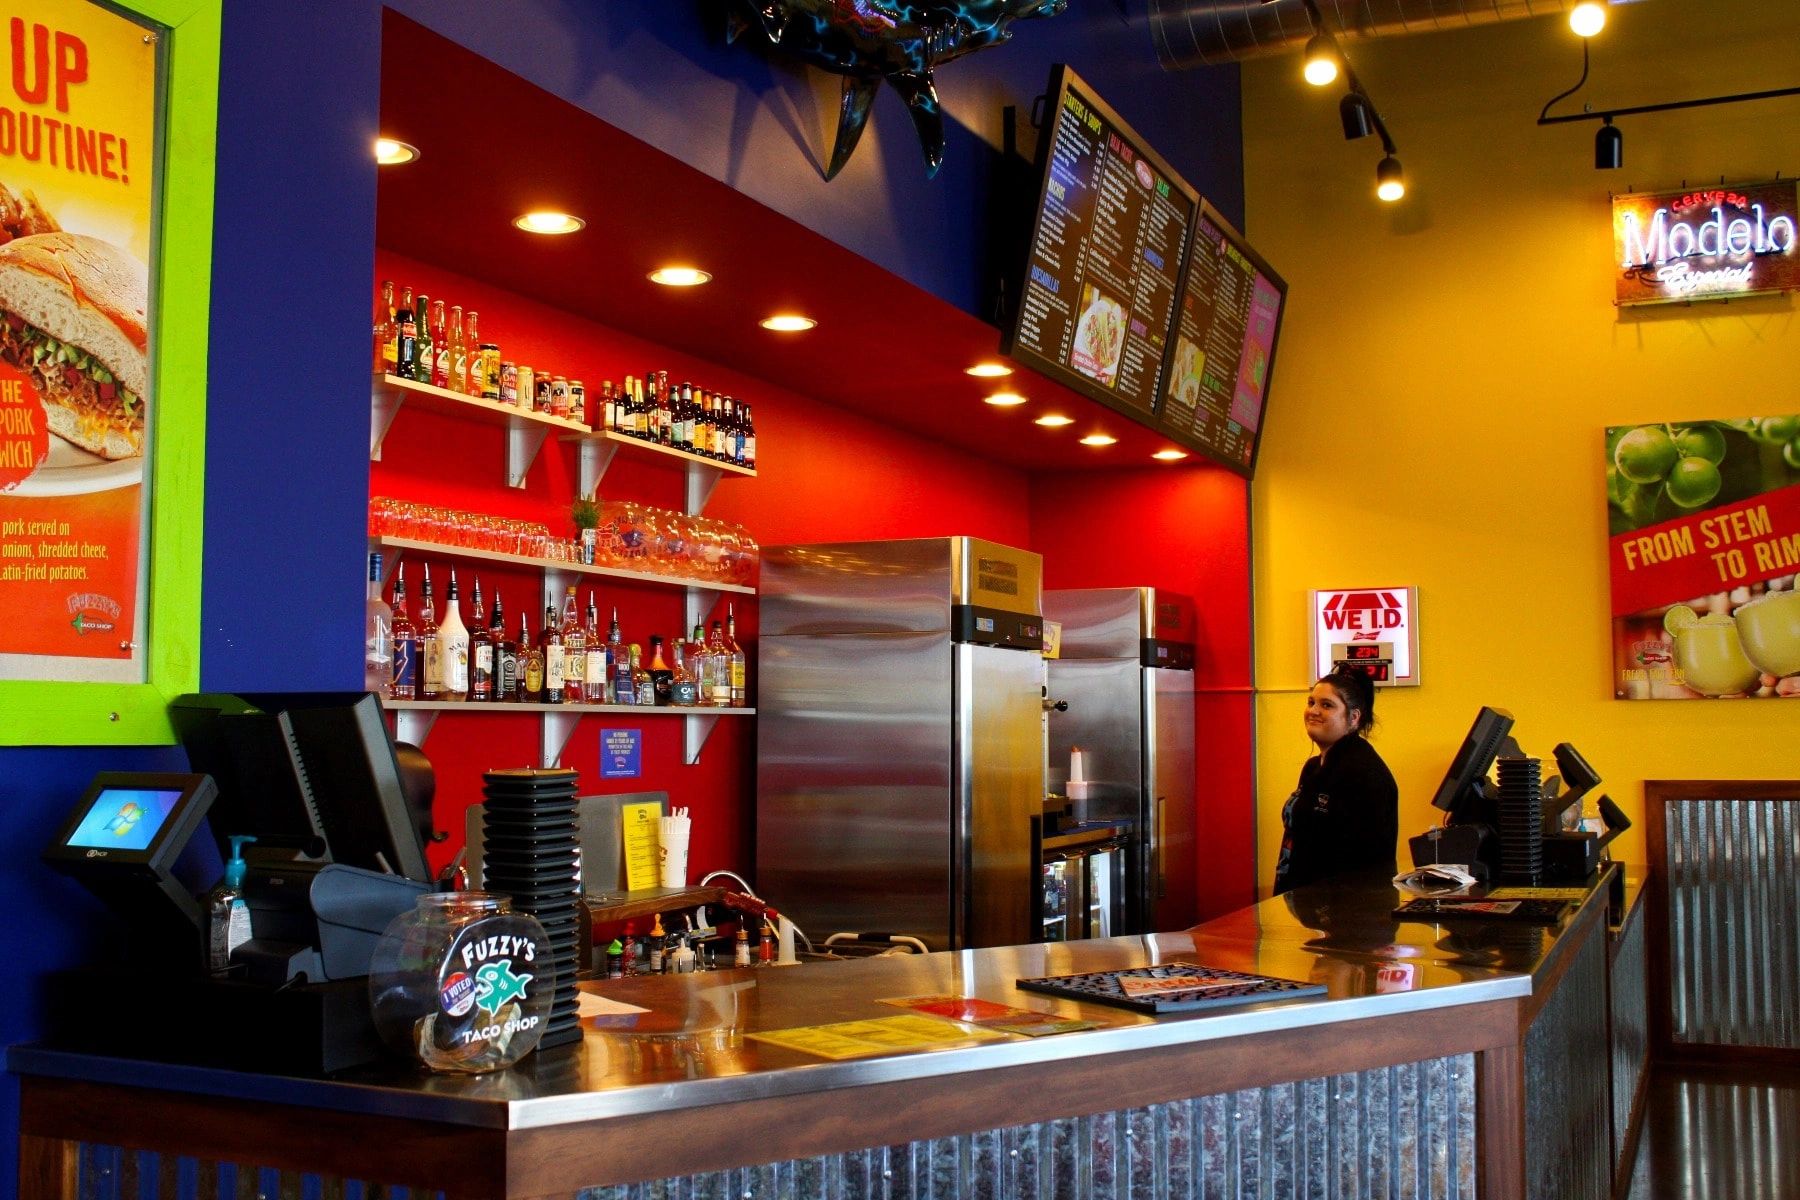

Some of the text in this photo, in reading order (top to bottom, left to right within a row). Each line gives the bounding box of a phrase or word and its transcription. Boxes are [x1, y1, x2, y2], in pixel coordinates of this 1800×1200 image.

[10, 16, 89, 113] UP
[1622, 203, 1796, 268] Modelo
[0, 379, 24, 404] HE
[3, 517, 70, 539] pork served on
[1622, 505, 1772, 571] FROM STEM
[3, 540, 109, 560] onions, shredded cheese,
[50, 564, 89, 583] potatoes.
[1711, 550, 1747, 582] TO
[1323, 608, 1404, 630] WE I.D.
[462, 935, 536, 969] FUZZY'S
[443, 977, 471, 1003] I VOTED
[462, 1015, 539, 1044] TACO SHOP
